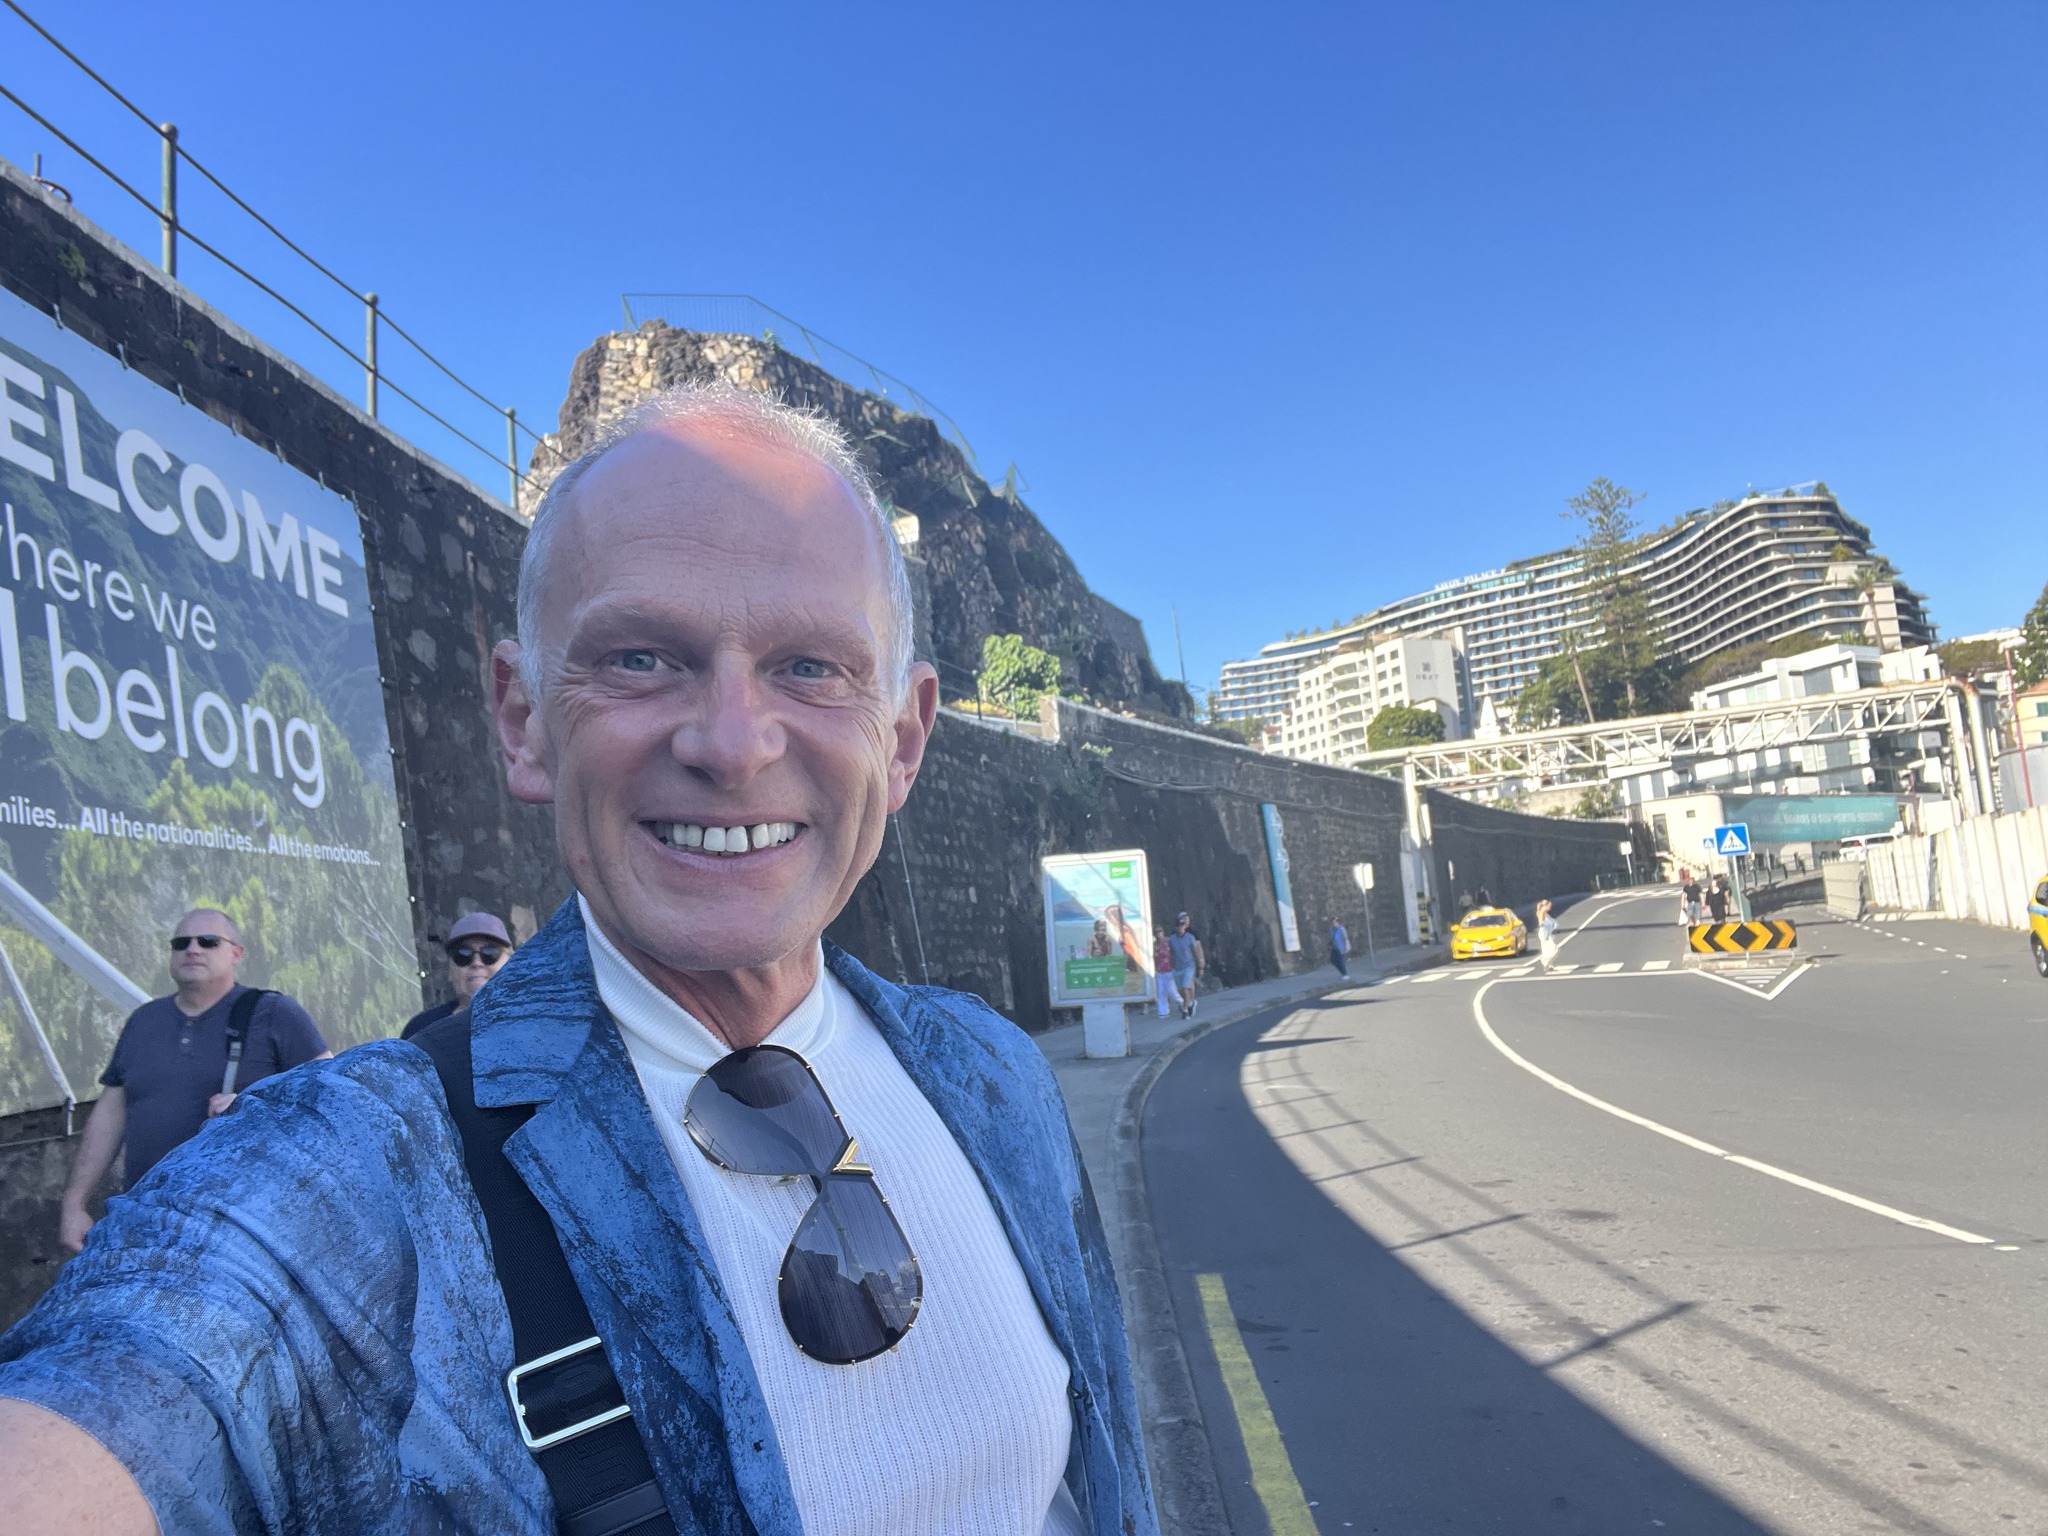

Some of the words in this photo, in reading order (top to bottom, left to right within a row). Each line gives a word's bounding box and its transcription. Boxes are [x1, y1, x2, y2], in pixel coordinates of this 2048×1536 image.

[0, 503, 135, 620] here
[141, 583, 217, 651] we
[45, 603, 325, 808] belong
[80, 807, 109, 836] All
[109, 812, 144, 840] the
[146, 822, 267, 854] nationalities...
[268, 833, 287, 856] All
[288, 838, 313, 859] the
[313, 843, 381, 866] emotions...
